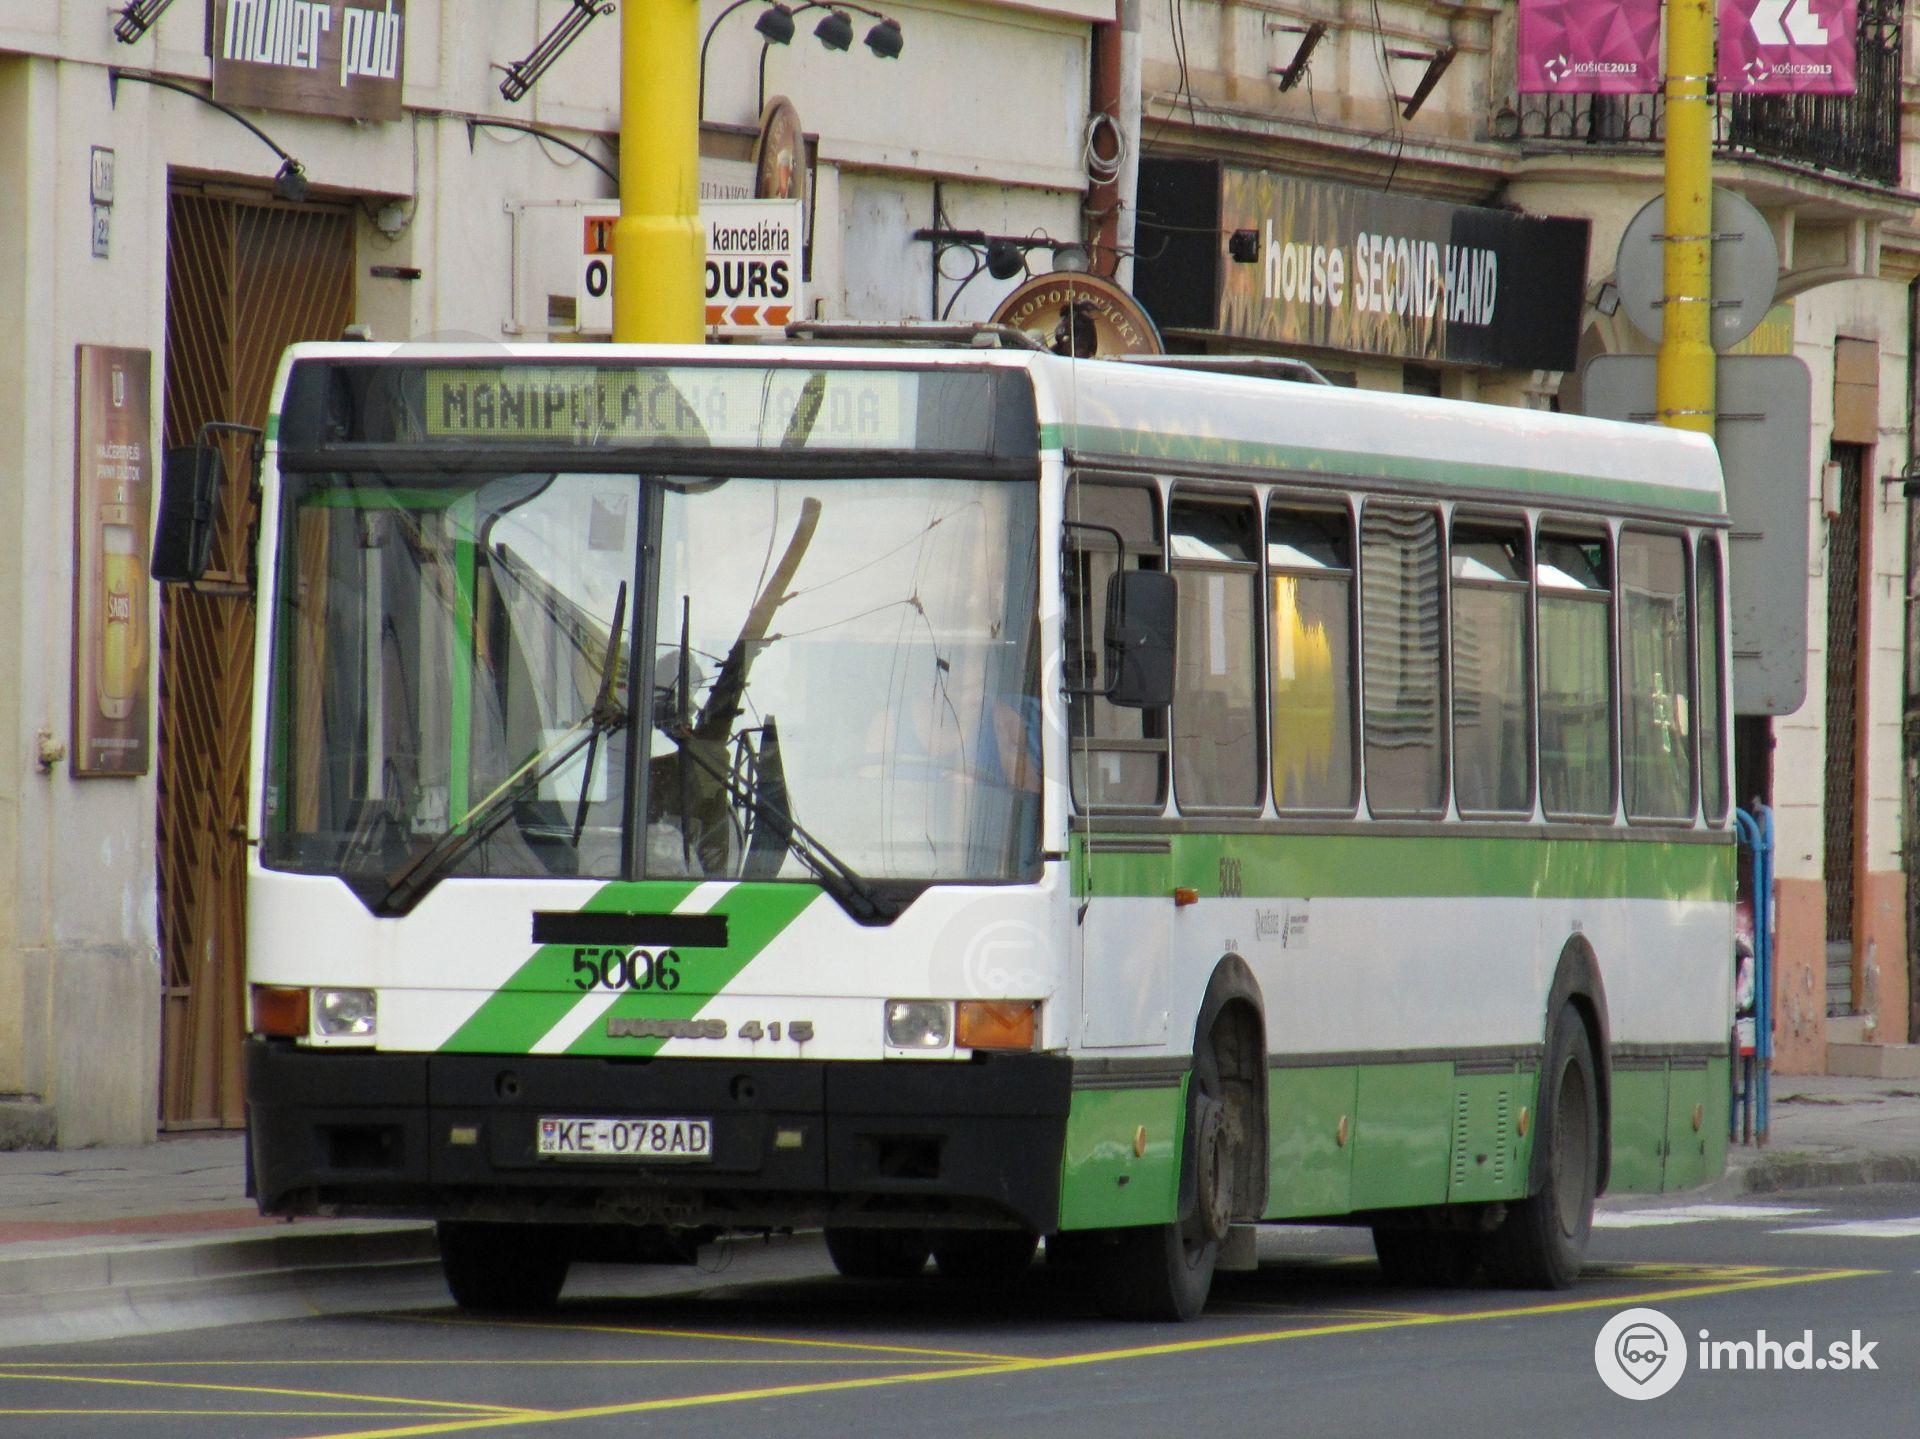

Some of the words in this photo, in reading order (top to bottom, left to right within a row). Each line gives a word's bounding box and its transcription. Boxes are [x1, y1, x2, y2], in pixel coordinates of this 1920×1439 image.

[340, 0, 400, 87] pub
[1574, 61, 1638, 74] KOŠICE2013
[1771, 63, 1833, 75] KOŠICE2013
[713, 219, 790, 251] kancelária
[1265, 219, 1345, 307] house
[1356, 232, 1440, 318] SECOND
[1442, 244, 1498, 326] HAND
[572, 948, 681, 991] 5006
[737, 1020, 815, 1043] 415
[558, 1122, 707, 1152] KE-078AD
